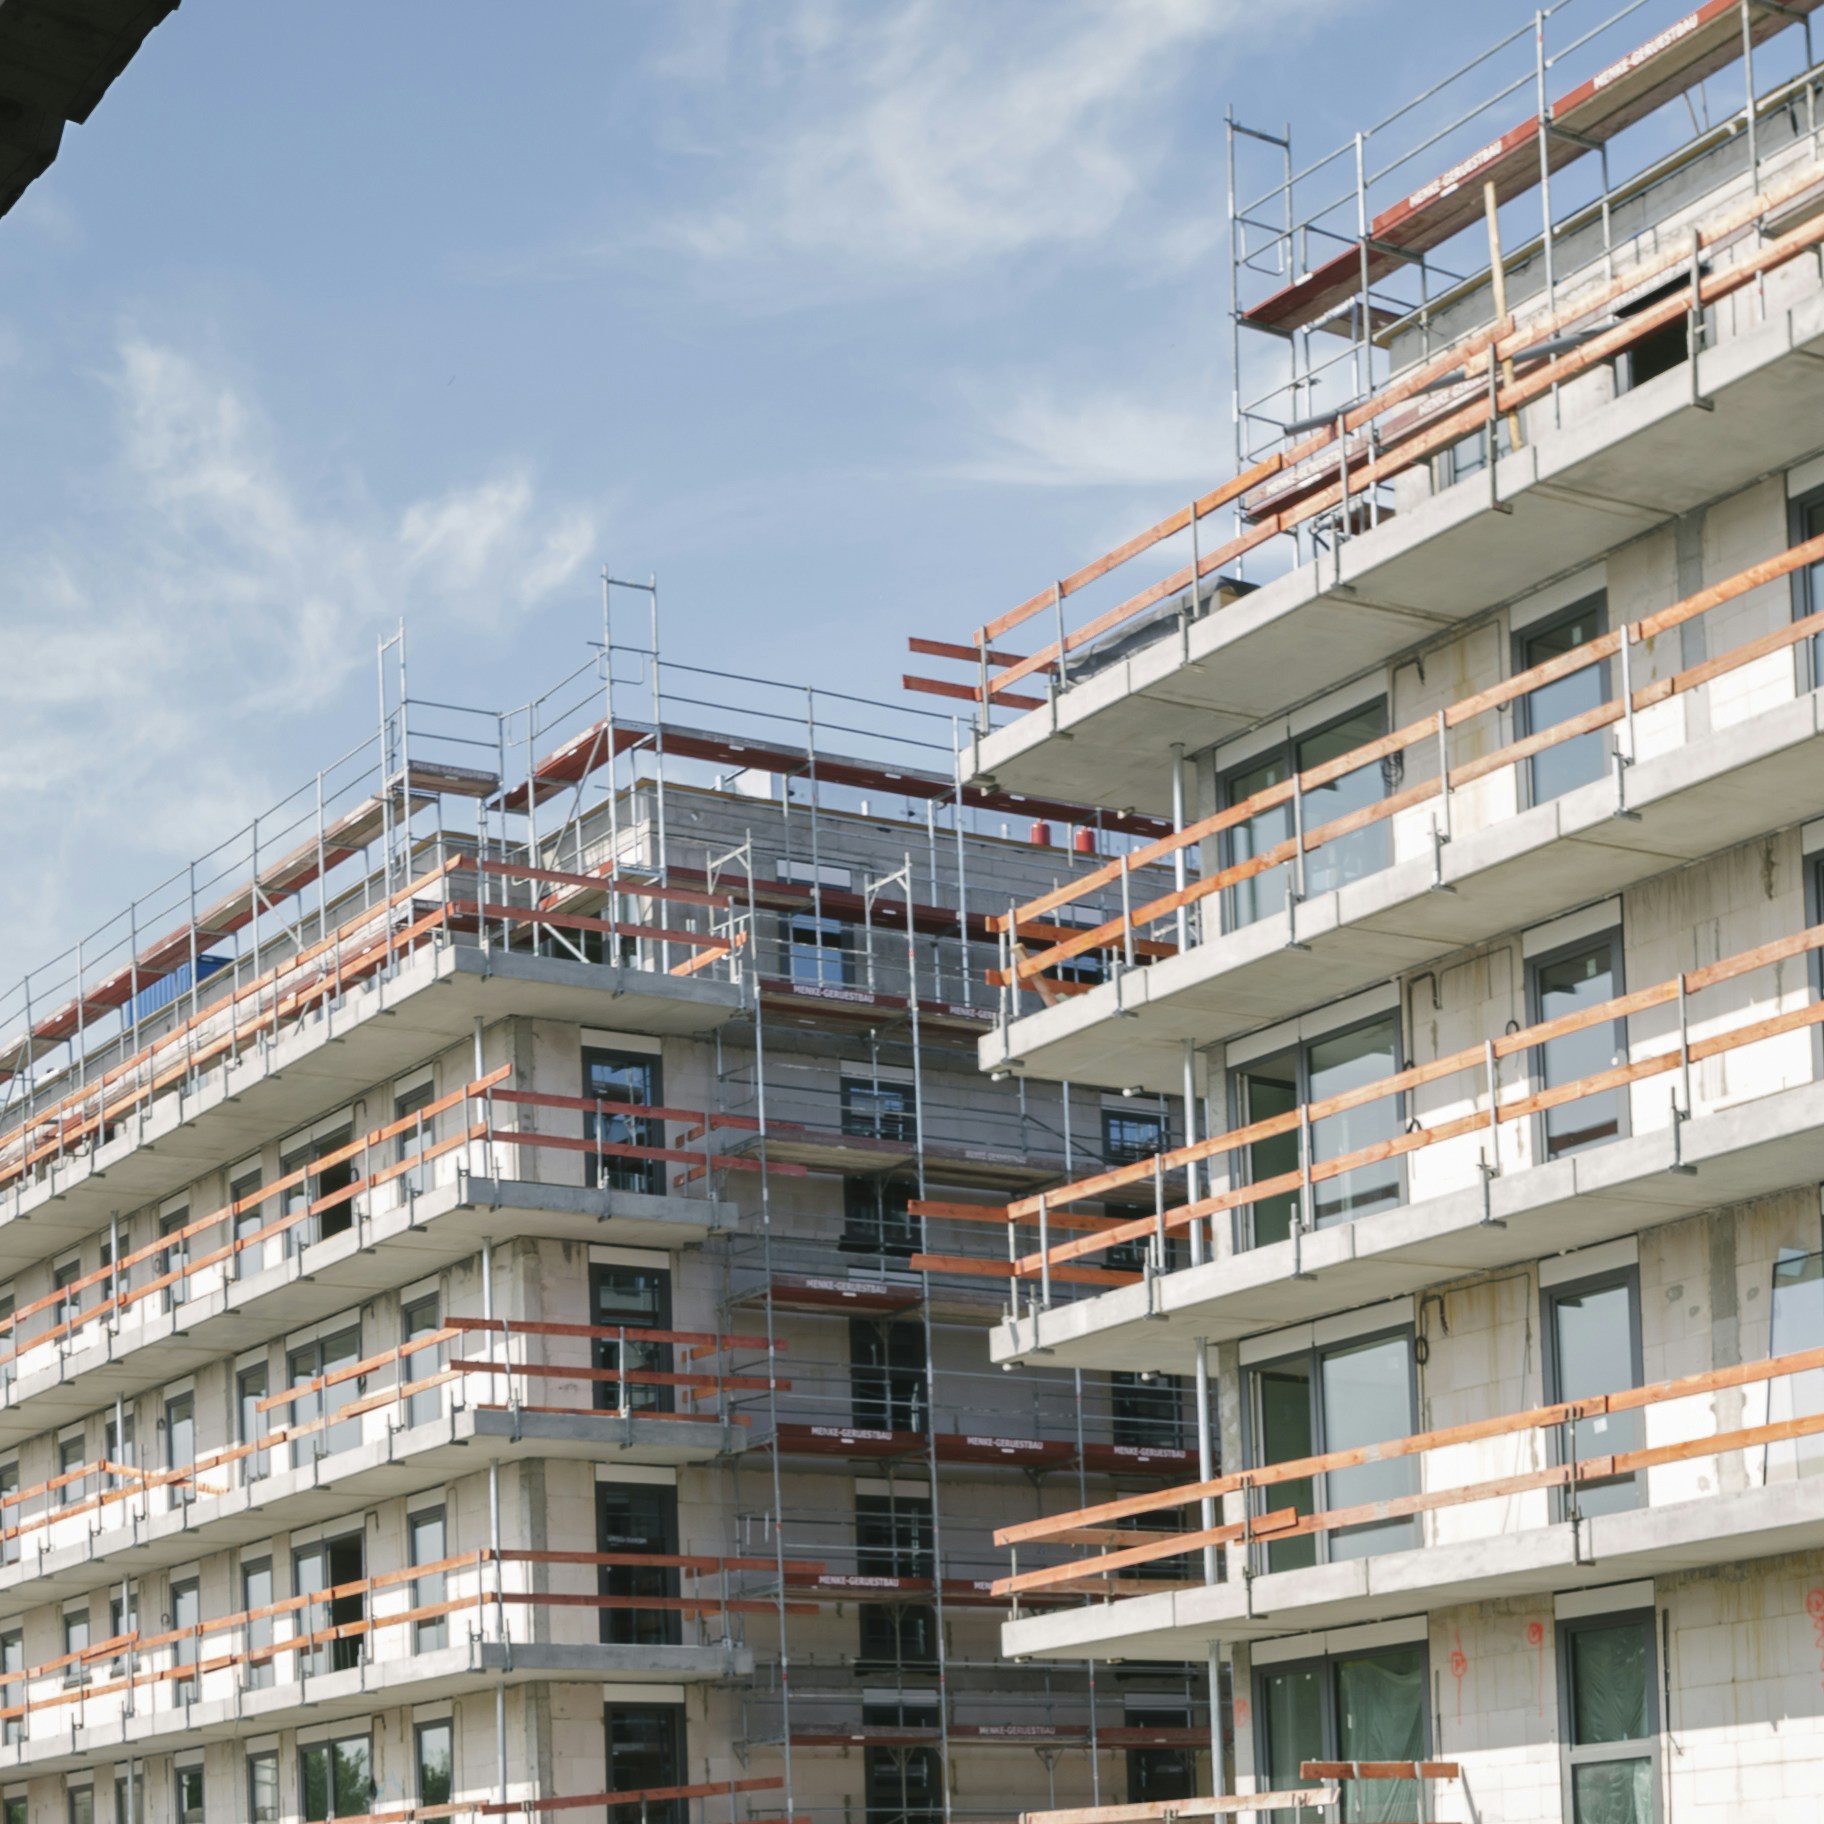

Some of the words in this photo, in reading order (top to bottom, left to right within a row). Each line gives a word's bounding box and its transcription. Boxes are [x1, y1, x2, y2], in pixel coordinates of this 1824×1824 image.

[792, 983, 875, 1004] MENKE-GERUESTBAU
[805, 1279, 888, 1295] MENKE-GERUESTBAU
[811, 1426, 893, 1441] MENKE-GERUESTBAU
[966, 1436, 1044, 1451] MENKE-GERUESTBAU
[1113, 1446, 1186, 1459] MENKE-GERUESTBAU
[818, 1575, 900, 1589] MENKE-GERUESTBAU
[978, 1725, 1056, 1736] MENKE-GERUESTBAU
